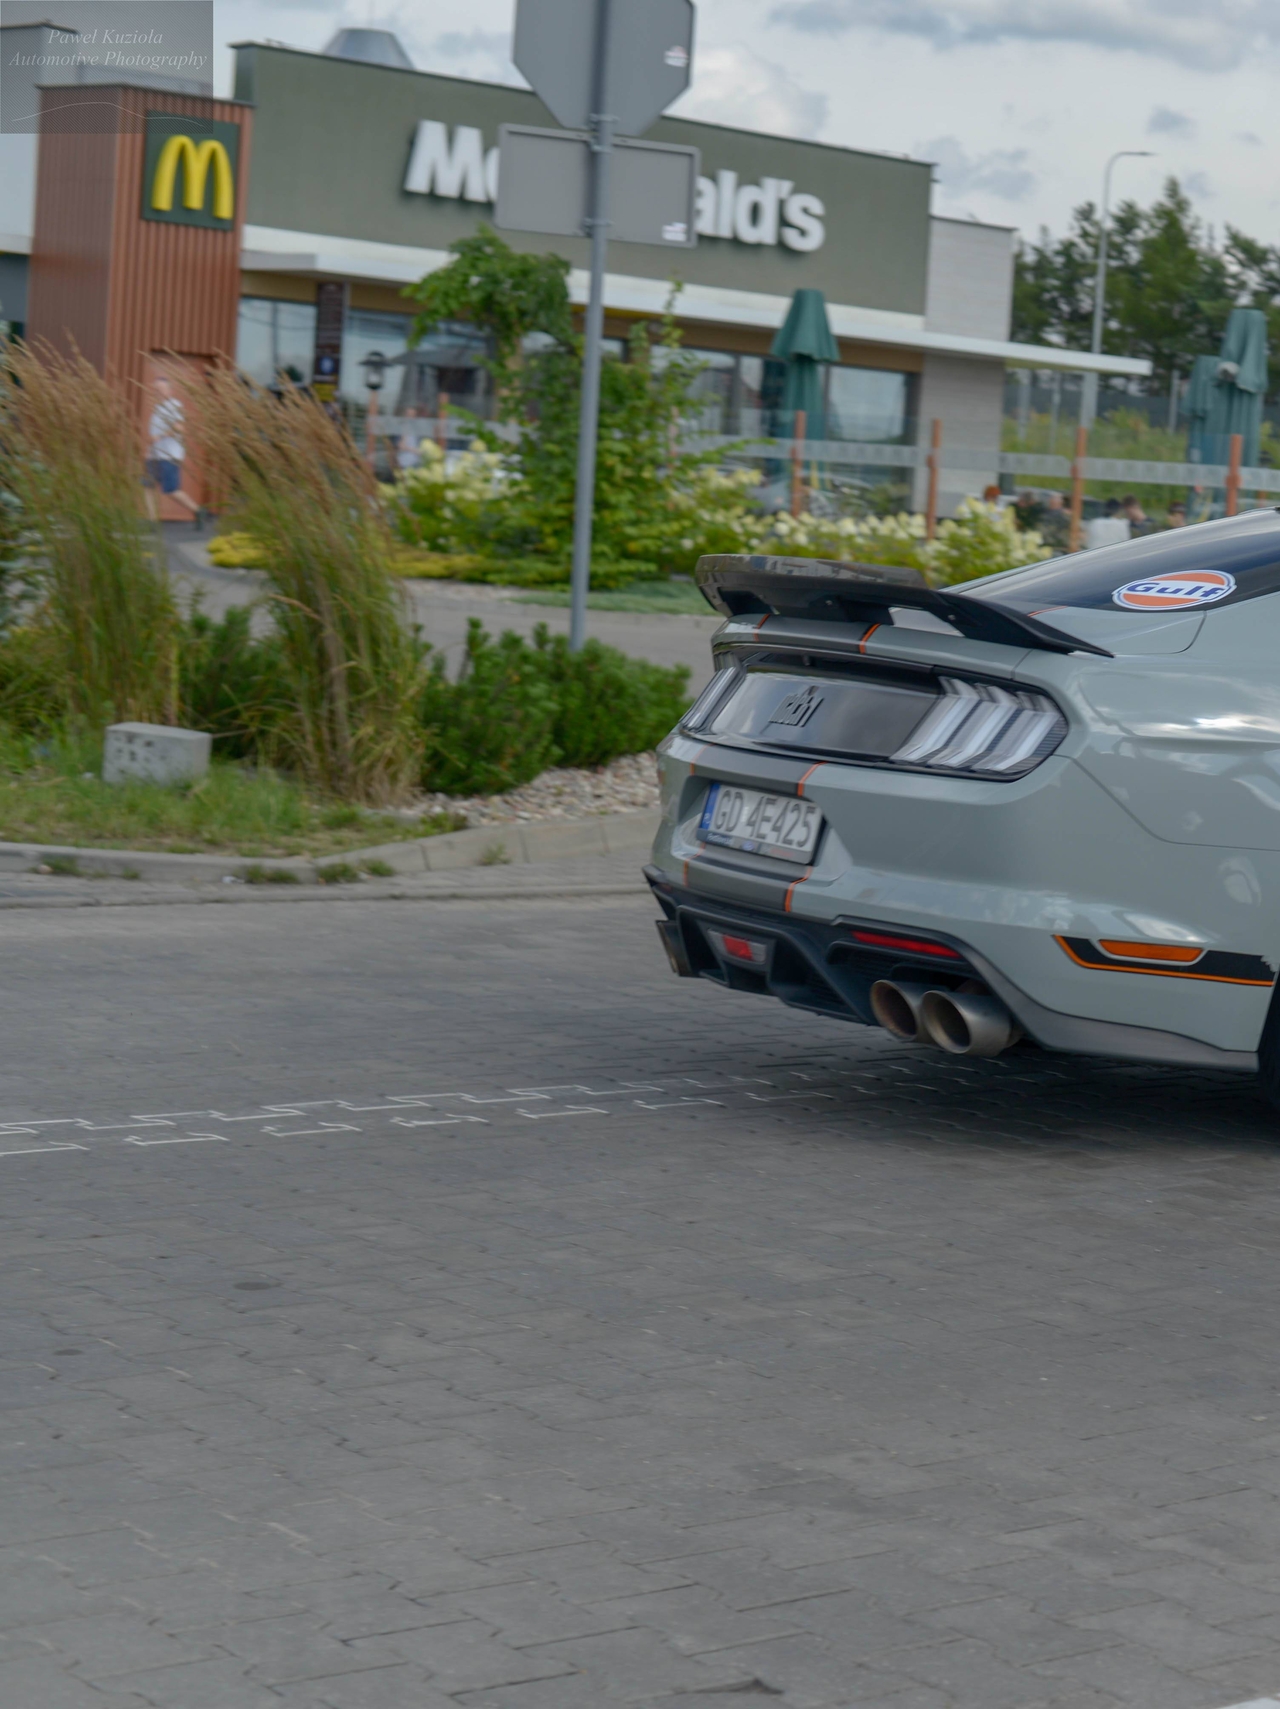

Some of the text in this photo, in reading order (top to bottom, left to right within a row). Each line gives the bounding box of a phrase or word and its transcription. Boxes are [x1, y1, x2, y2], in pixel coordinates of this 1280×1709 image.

[1126, 582, 1226, 598] Gulf
[713, 789, 816, 849] GD 4E425
